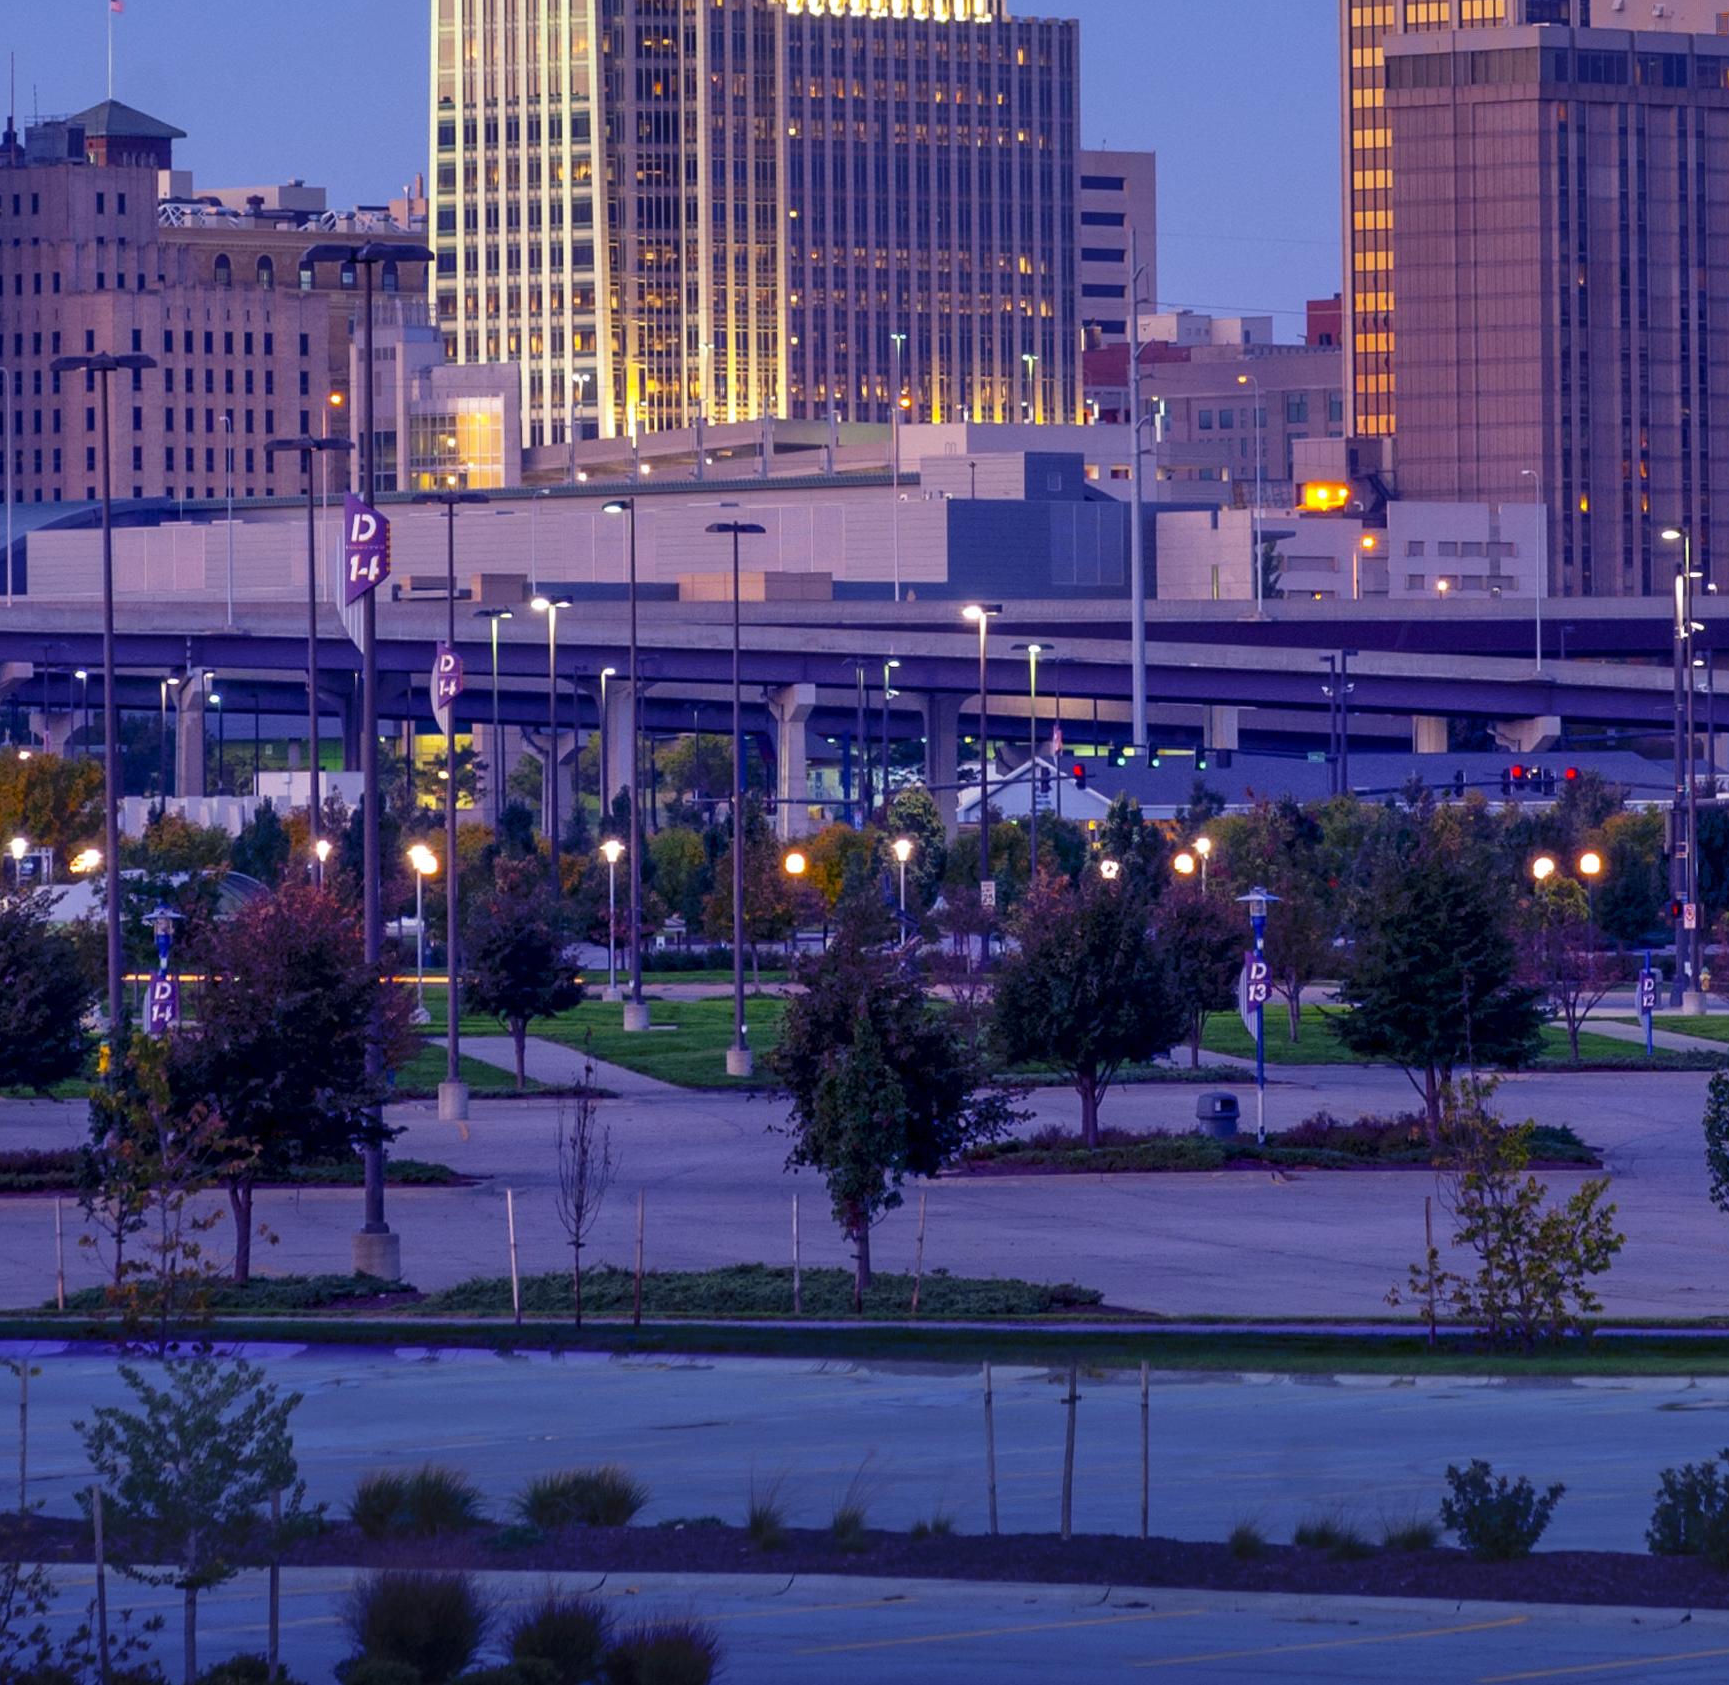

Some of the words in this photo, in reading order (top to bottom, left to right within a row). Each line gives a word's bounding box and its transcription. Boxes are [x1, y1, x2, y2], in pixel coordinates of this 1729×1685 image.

[350, 513, 377, 542] D
[439, 654, 455, 672] D
[1250, 962, 1267, 980] D
[154, 980, 172, 1000] D
[1248, 983, 1267, 1002] 13
